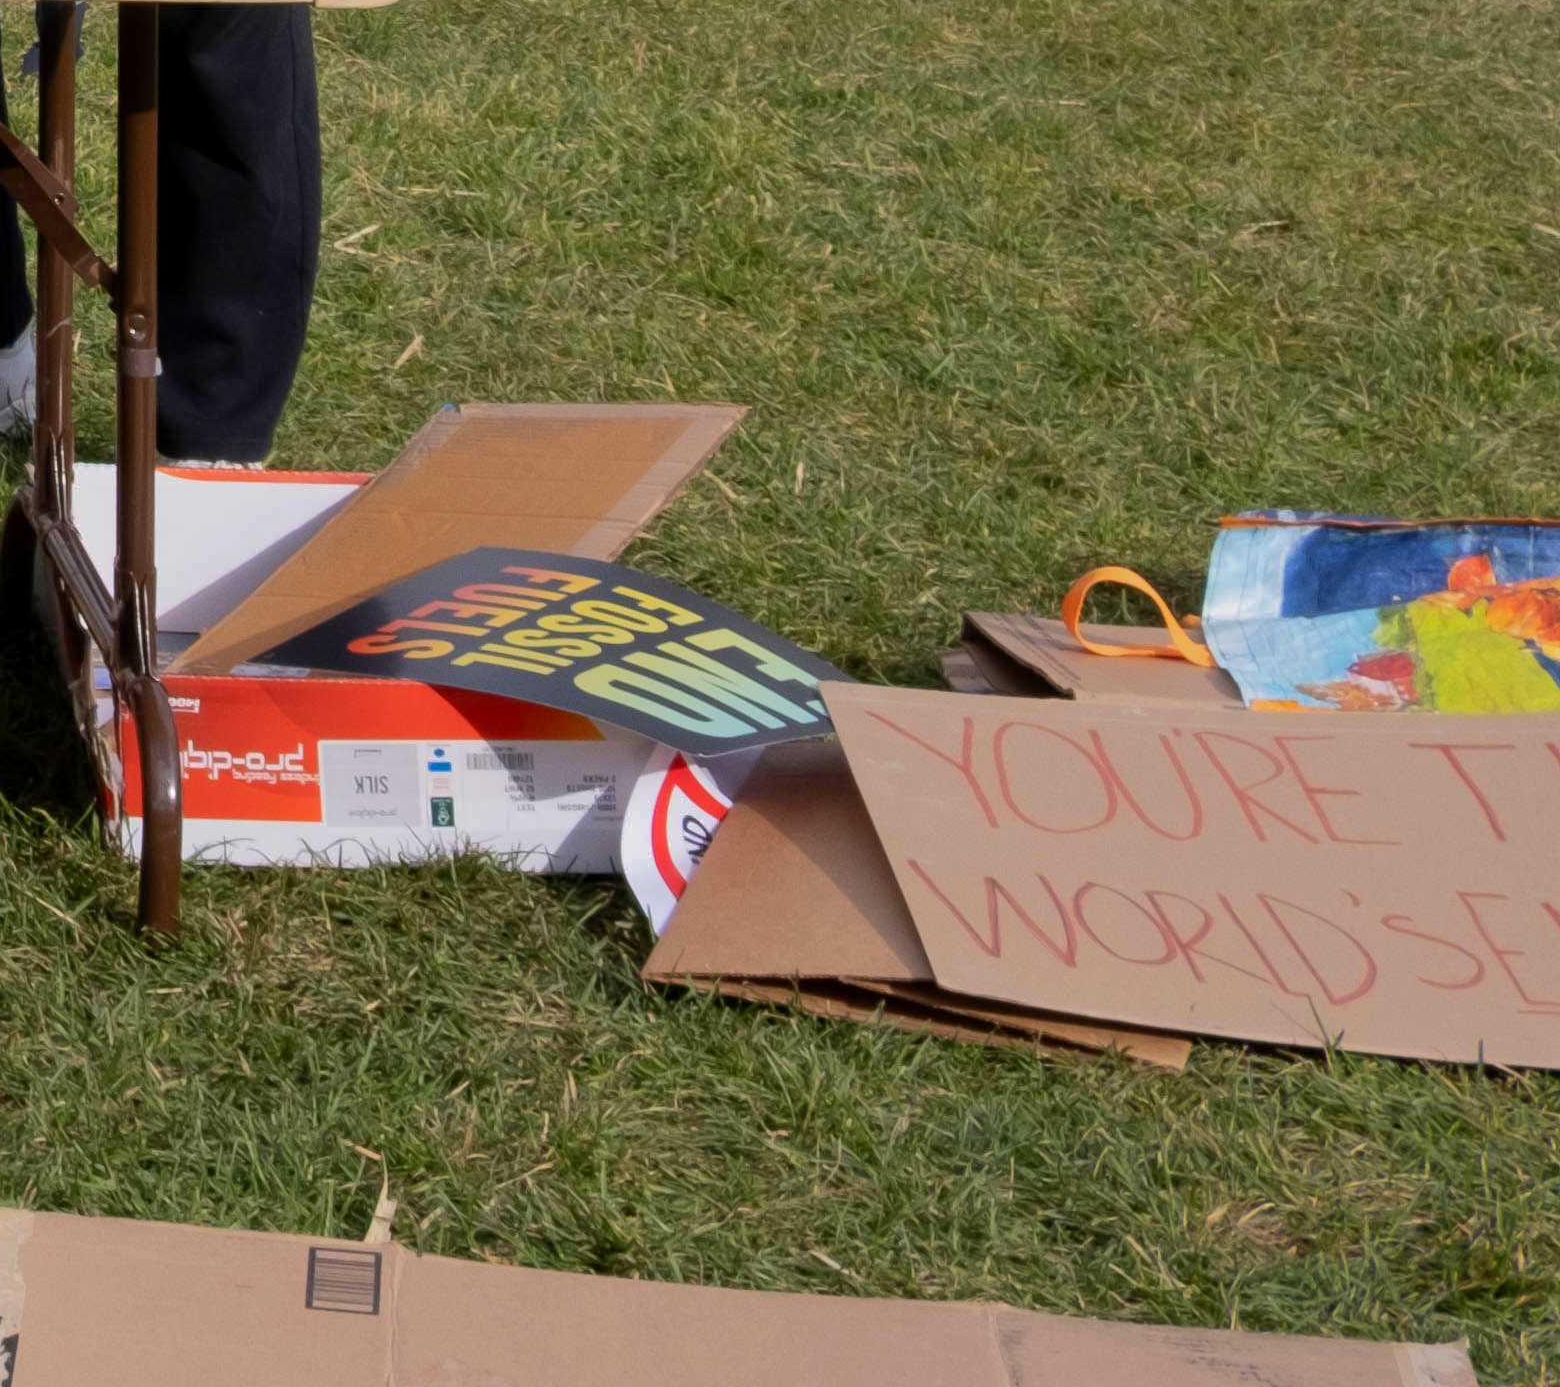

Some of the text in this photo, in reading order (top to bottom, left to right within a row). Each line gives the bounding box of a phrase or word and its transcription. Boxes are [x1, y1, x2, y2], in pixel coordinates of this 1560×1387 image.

[346, 565, 602, 660] FUELS
[451, 585, 705, 677] FOSSIL
[573, 628, 830, 739] END
[353, 775, 390, 794] SILK
[864, 709, 1402, 847] YOU'RE
